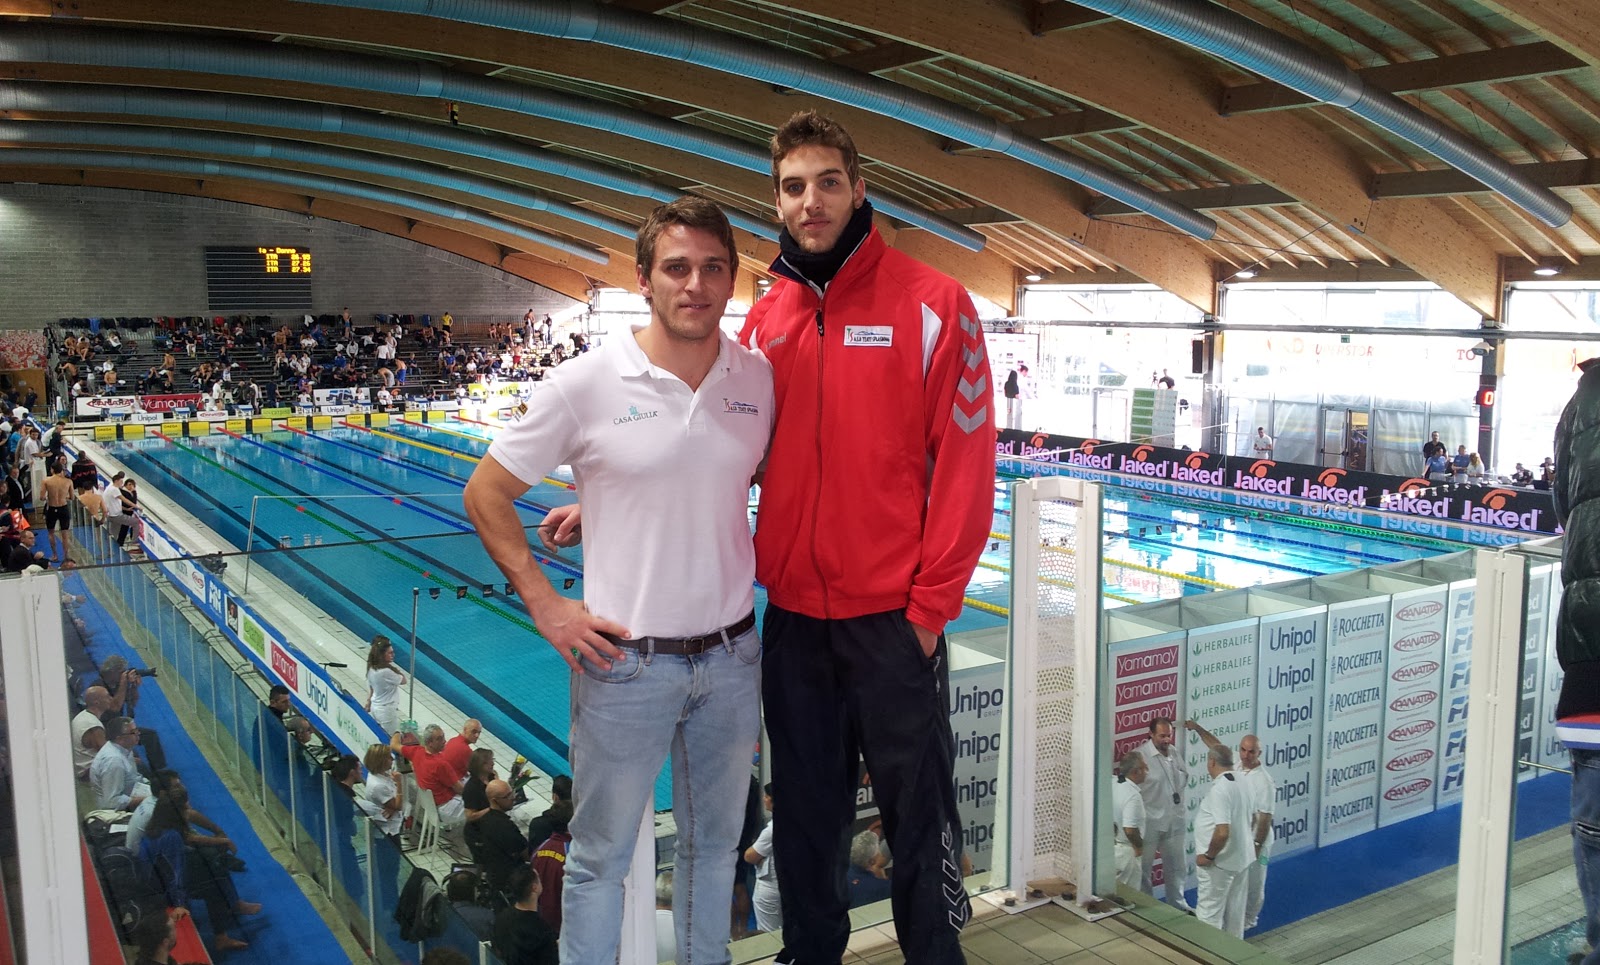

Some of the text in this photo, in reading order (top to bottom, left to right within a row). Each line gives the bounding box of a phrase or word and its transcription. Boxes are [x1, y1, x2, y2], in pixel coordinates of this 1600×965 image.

[138, 414, 158, 422] Unipol
[327, 406, 345, 414] Unipol
[613, 411, 658, 425] CASA GIULIA
[1020, 441, 1060, 463] Jaked
[1068, 447, 1112, 470] Jaked
[1119, 454, 1167, 479] Jaked
[1171, 461, 1223, 486] Jaked
[1234, 470, 1291, 496] Jaked
[1301, 478, 1364, 507] Jaked
[1380, 488, 1450, 518] Jaked
[1461, 500, 1538, 531] Jaked
[1399, 603, 1441, 618] PANATTA
[1270, 620, 1316, 654] Unipol
[1339, 613, 1384, 637] ROCCHETTA
[1204, 634, 1253, 652] HERBALIFE
[1398, 632, 1439, 648] PANATTA
[1203, 656, 1252, 674] HERBALIFE
[1337, 650, 1382, 675] ROCCHETTA
[1396, 663, 1437, 678] PANATTA
[1202, 678, 1251, 696] HERBALIFE
[1268, 658, 1315, 693] Unipol
[305, 669, 329, 715] Unipol
[1335, 687, 1380, 712] ROCCHETTA
[1394, 692, 1435, 708] PANATTA
[1201, 699, 1250, 718] HERBALIFE
[1267, 696, 1312, 731] Unipol
[1208, 721, 1250, 737] RBALIFE
[1333, 723, 1378, 749] ROCCHETTA
[1392, 721, 1433, 737] PANATTA
[955, 730, 1000, 763] nipo
[1265, 734, 1311, 769] Unipol
[1391, 751, 1431, 767] PANATTA
[1331, 760, 1376, 786] ROCCHETTA
[1275, 772, 1309, 807] nipol
[1388, 780, 1429, 796] PANATTA
[1330, 796, 1374, 823] ROCCHETTA
